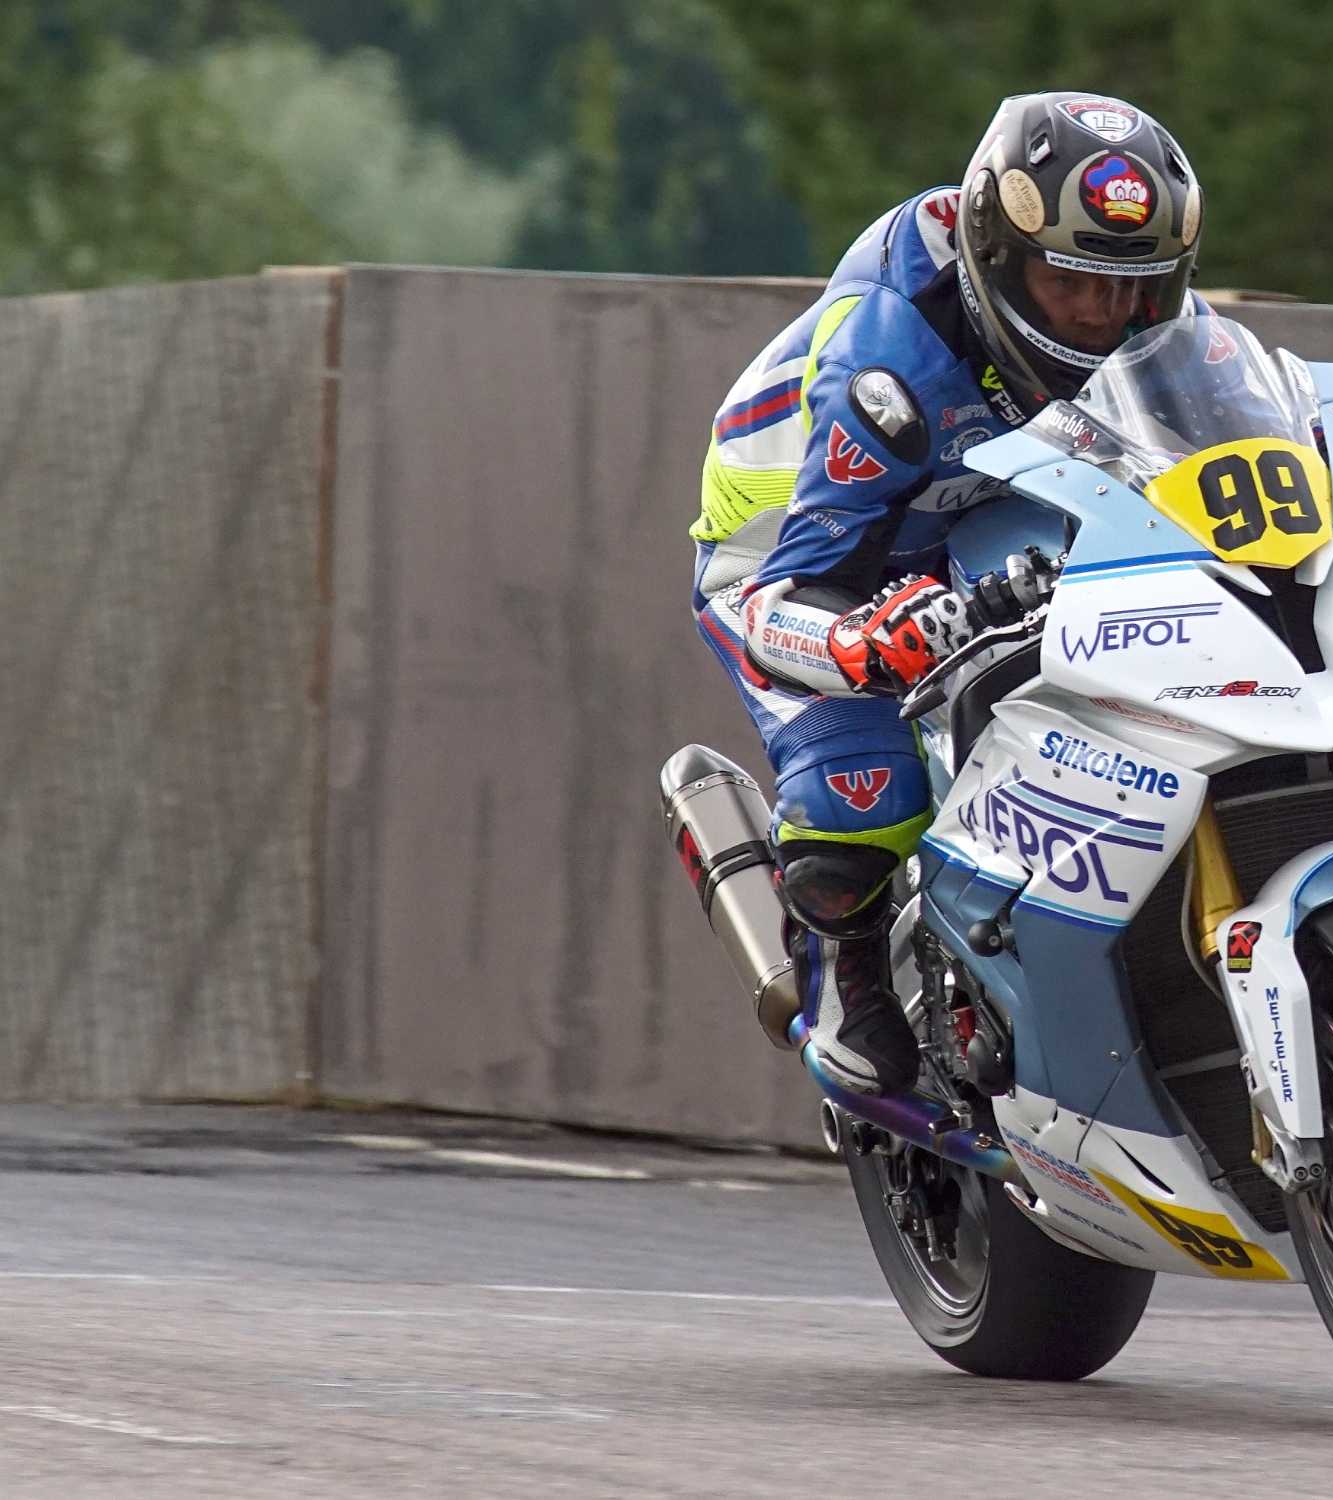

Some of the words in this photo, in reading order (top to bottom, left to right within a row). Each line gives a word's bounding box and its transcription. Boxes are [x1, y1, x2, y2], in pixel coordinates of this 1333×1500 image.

[1196, 450, 1323, 552] 99
[1061, 618, 1192, 664] WEPOL
[1154, 680, 1302, 701] PENZ13.COM
[1265, 986, 1294, 1103] METZELER
